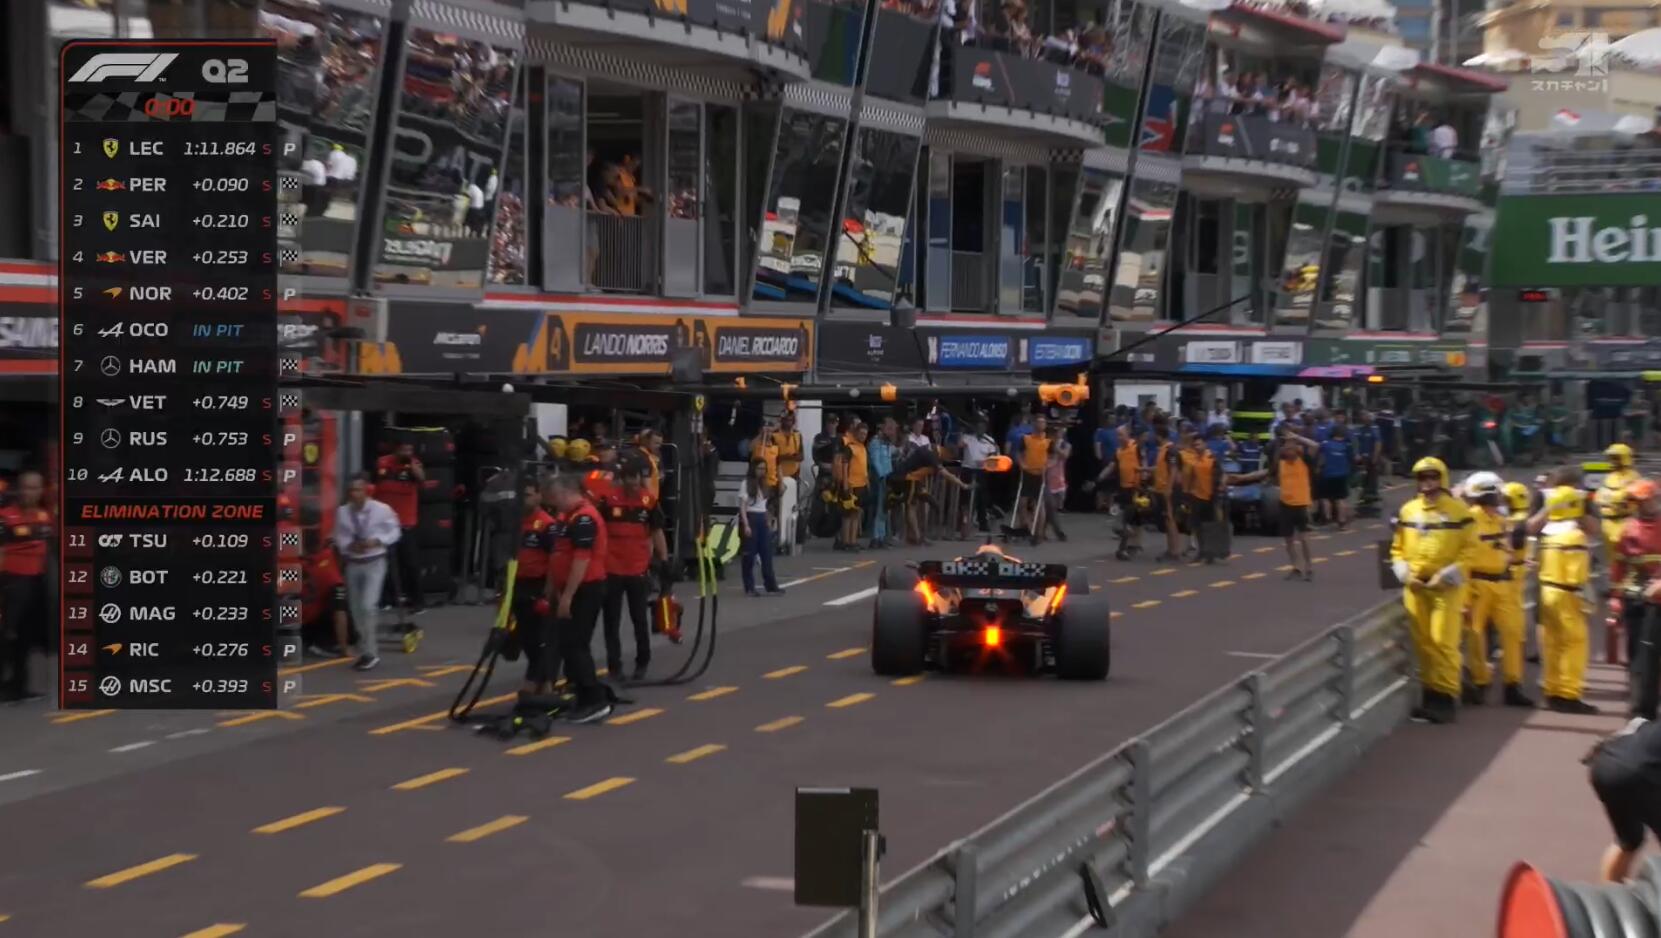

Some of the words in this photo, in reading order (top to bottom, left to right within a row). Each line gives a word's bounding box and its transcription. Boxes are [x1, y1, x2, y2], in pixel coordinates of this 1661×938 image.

[583, 333, 624, 355] LANDO
[625, 333, 669, 355] NORRIS
[719, 335, 751, 356] DANIEL
[942, 561, 989, 576] OKX
[998, 563, 1046, 577] OKX
